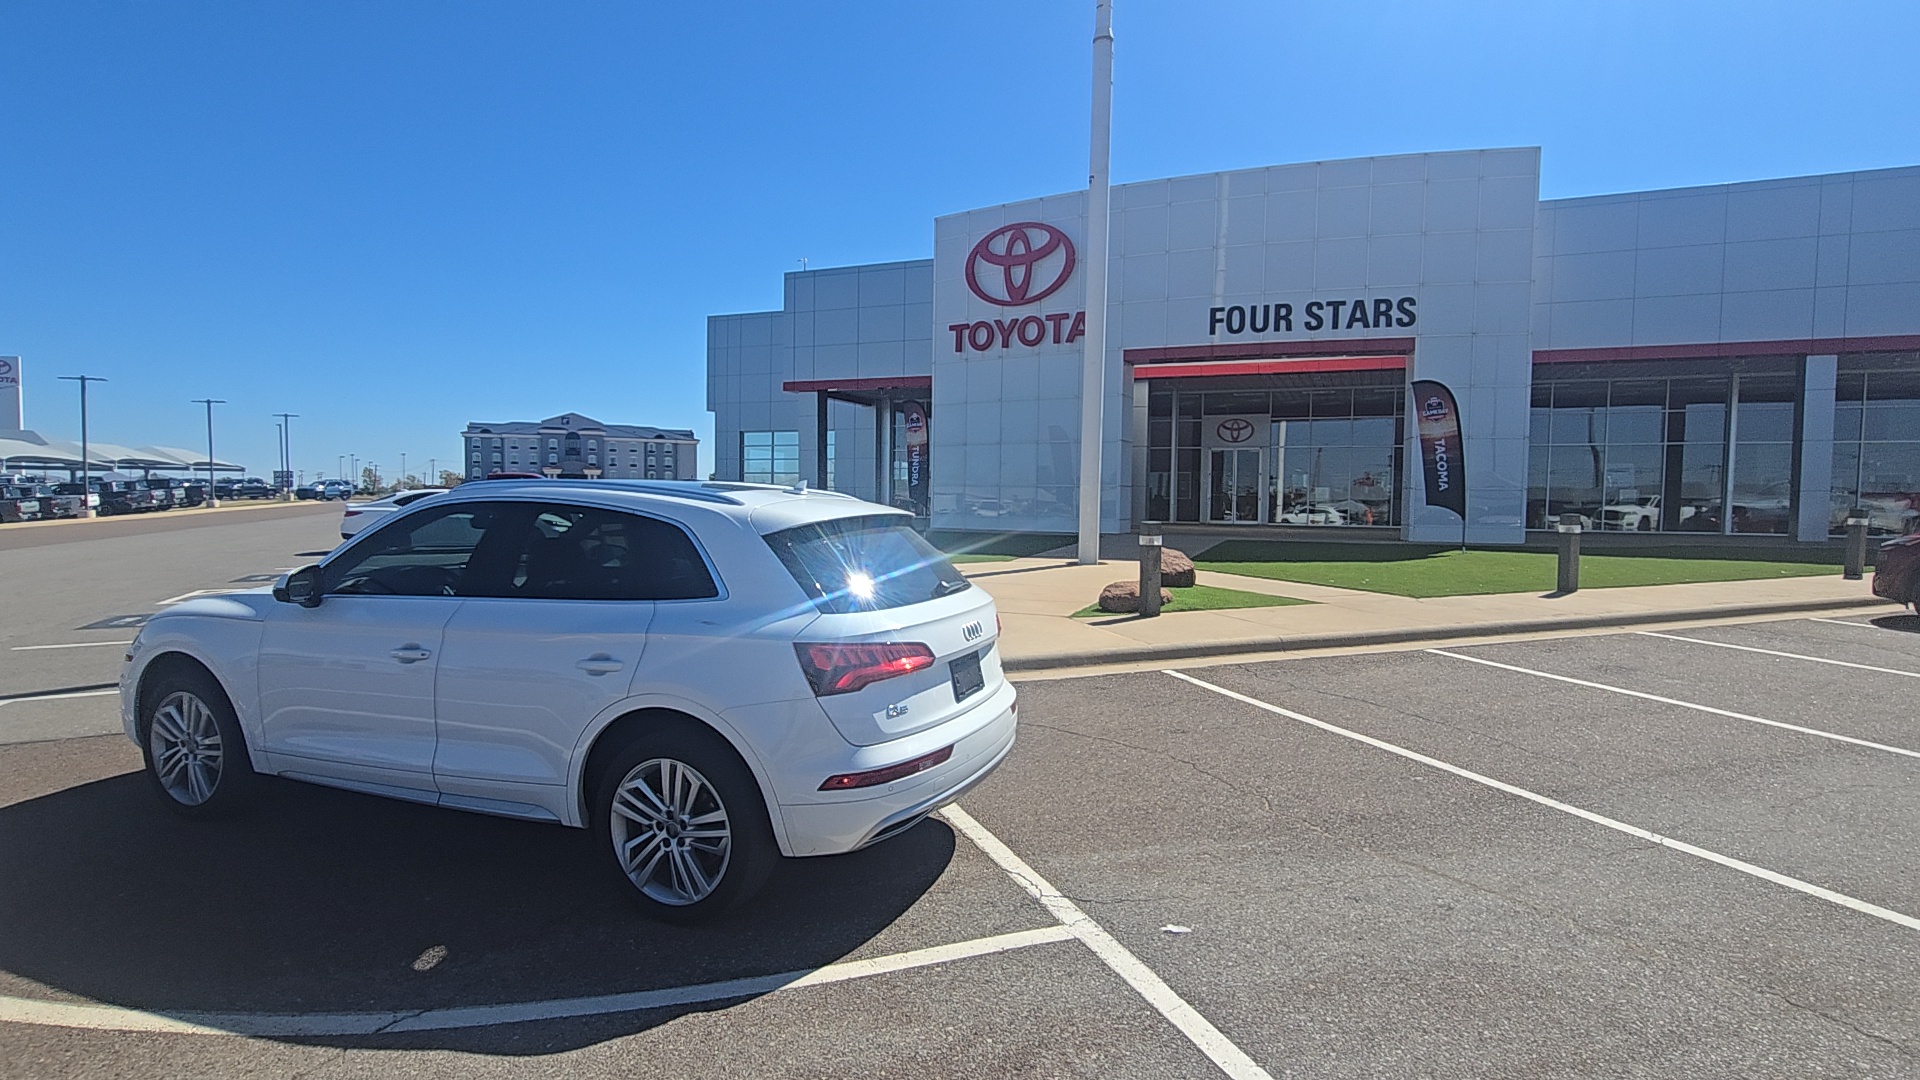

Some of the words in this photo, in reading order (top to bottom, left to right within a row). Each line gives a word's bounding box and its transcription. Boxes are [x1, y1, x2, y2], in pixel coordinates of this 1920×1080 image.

[949, 311, 1086, 353] TOYOTA
[1209, 303, 1293, 336] FOUR
[1304, 297, 1417, 331] STARS
[911, 445, 920, 487] TUNDRA
[1434, 438, 1449, 491] TACOMA
